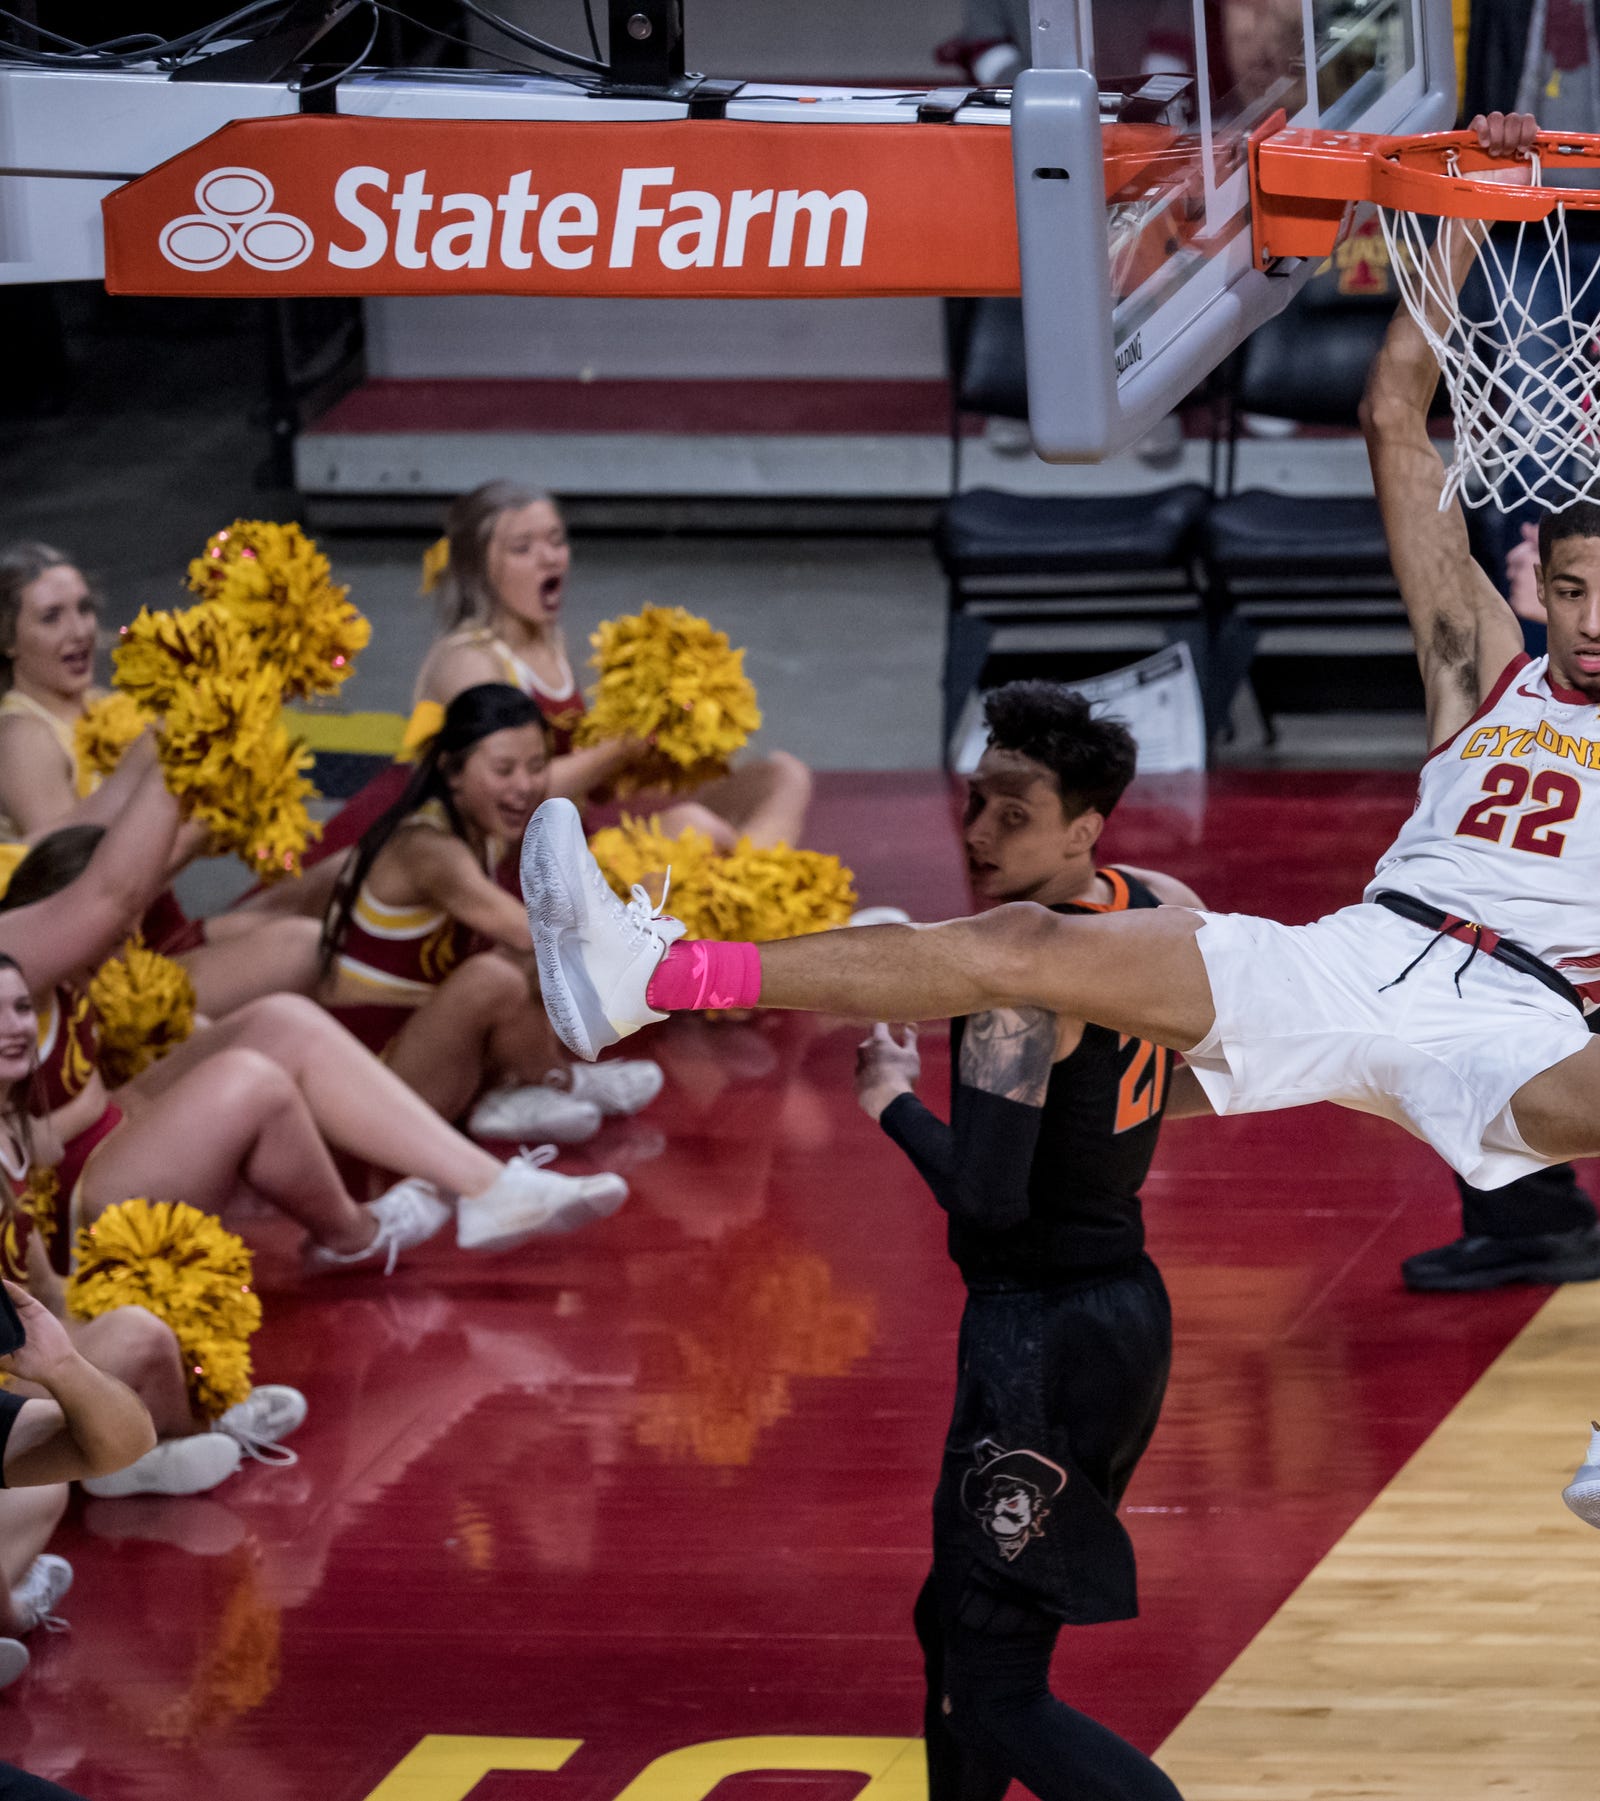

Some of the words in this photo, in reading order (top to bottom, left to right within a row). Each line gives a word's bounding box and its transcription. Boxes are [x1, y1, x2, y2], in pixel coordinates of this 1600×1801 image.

[328, 165, 599, 271] State
[609, 166, 869, 270] Farm
[1455, 763, 1581, 858] 22
